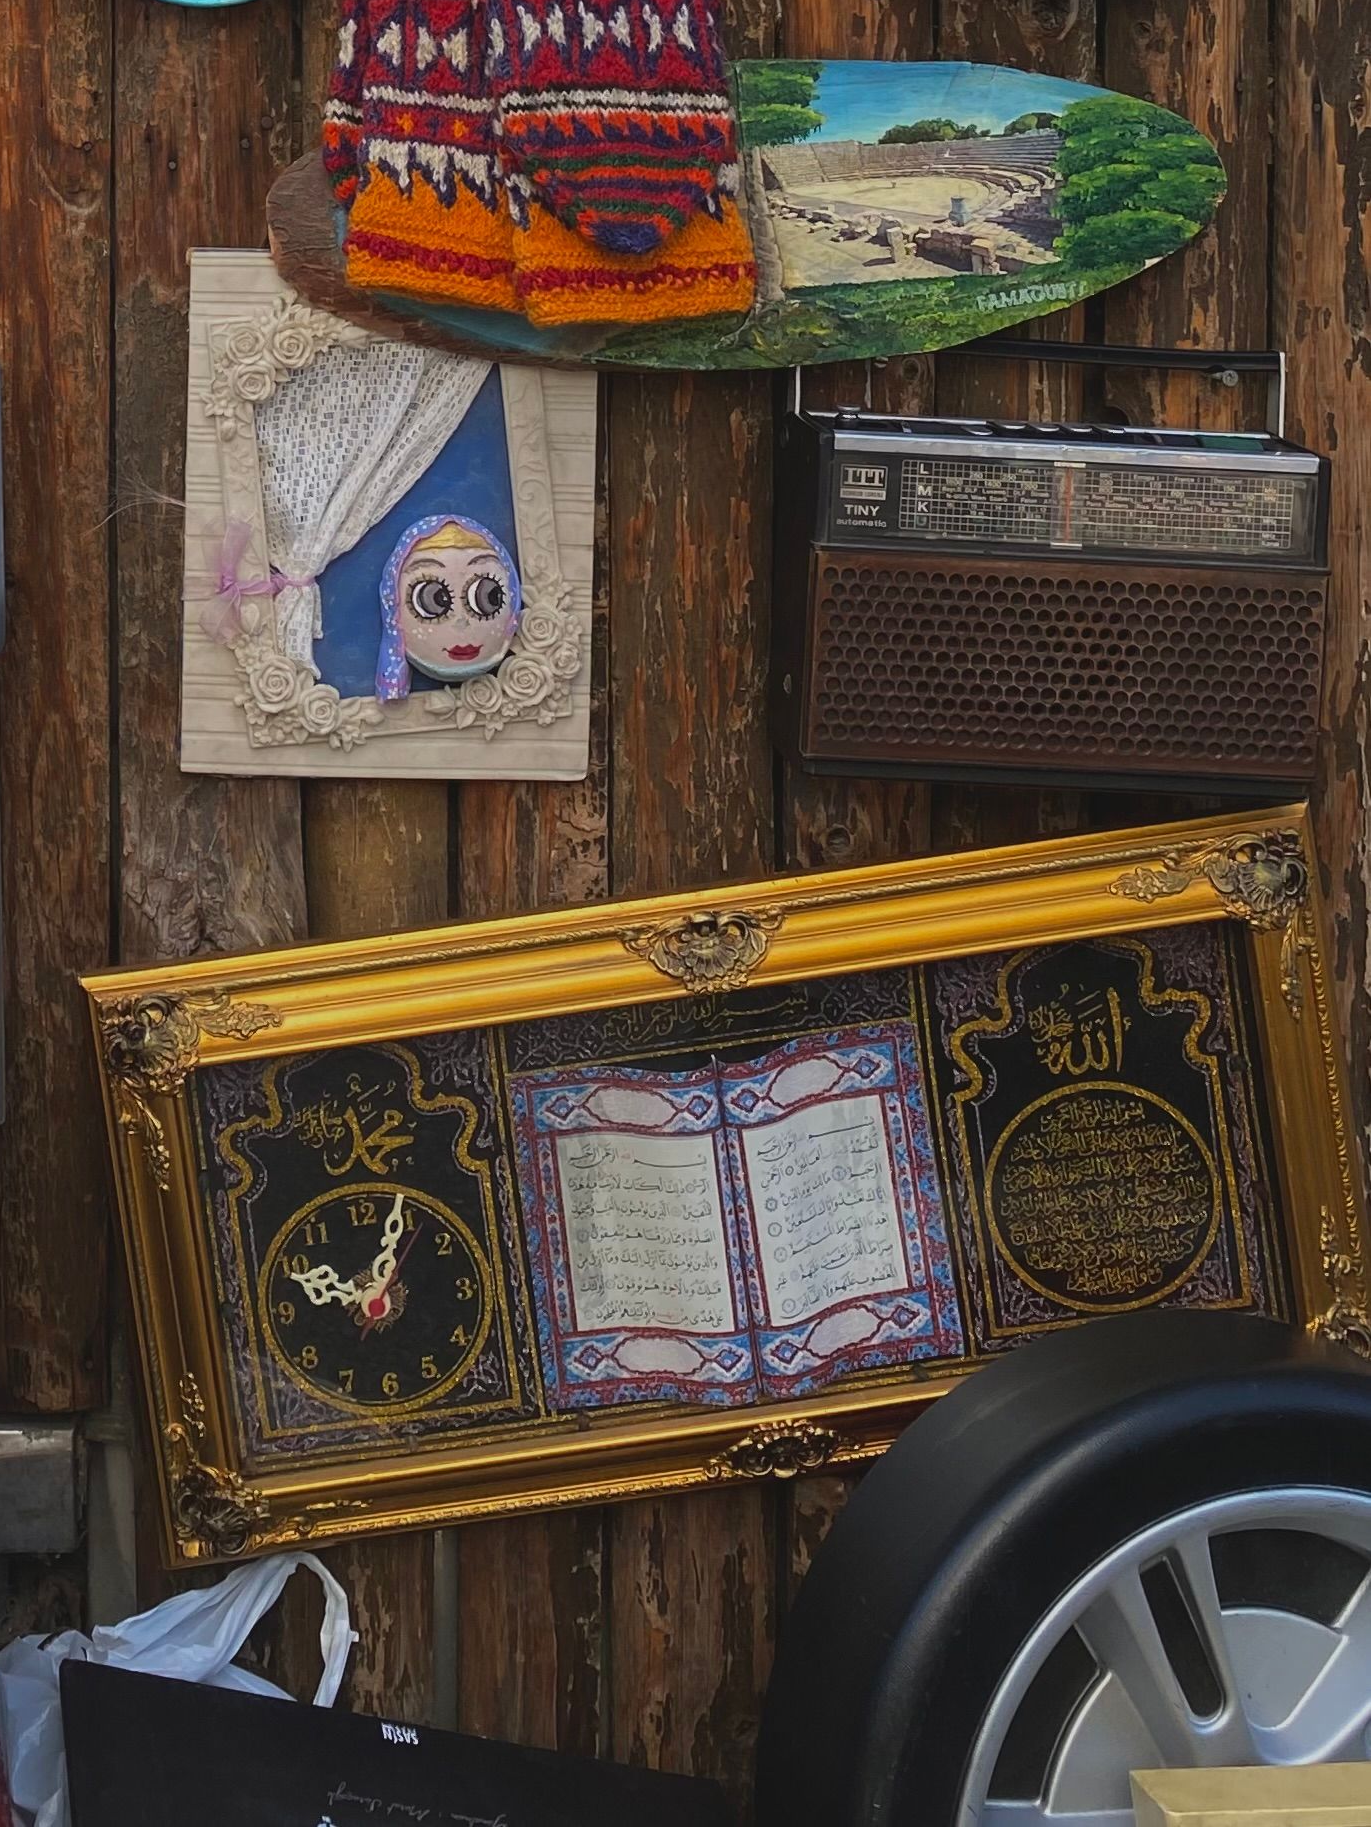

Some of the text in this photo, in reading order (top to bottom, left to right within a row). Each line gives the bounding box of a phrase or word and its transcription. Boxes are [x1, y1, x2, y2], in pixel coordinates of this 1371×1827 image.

[844, 467, 885, 487] ITT
[920, 463, 929, 474] L
[917, 485, 932, 496] M
[843, 504, 880, 516] TINY
[917, 501, 928, 512] K
[836, 517, 887, 528] automatic
[348, 1200, 378, 1229] 12
[403, 1206, 418, 1232] 1
[303, 1217, 329, 1246] 11
[434, 1232, 454, 1257] 2
[455, 1276, 476, 1301] 3
[277, 1302, 296, 1324] 9
[449, 1323, 472, 1347] 4
[301, 1344, 319, 1370] 8
[420, 1354, 438, 1379] 5
[338, 1368, 355, 1394] 7
[382, 1370, 400, 1396] 6
